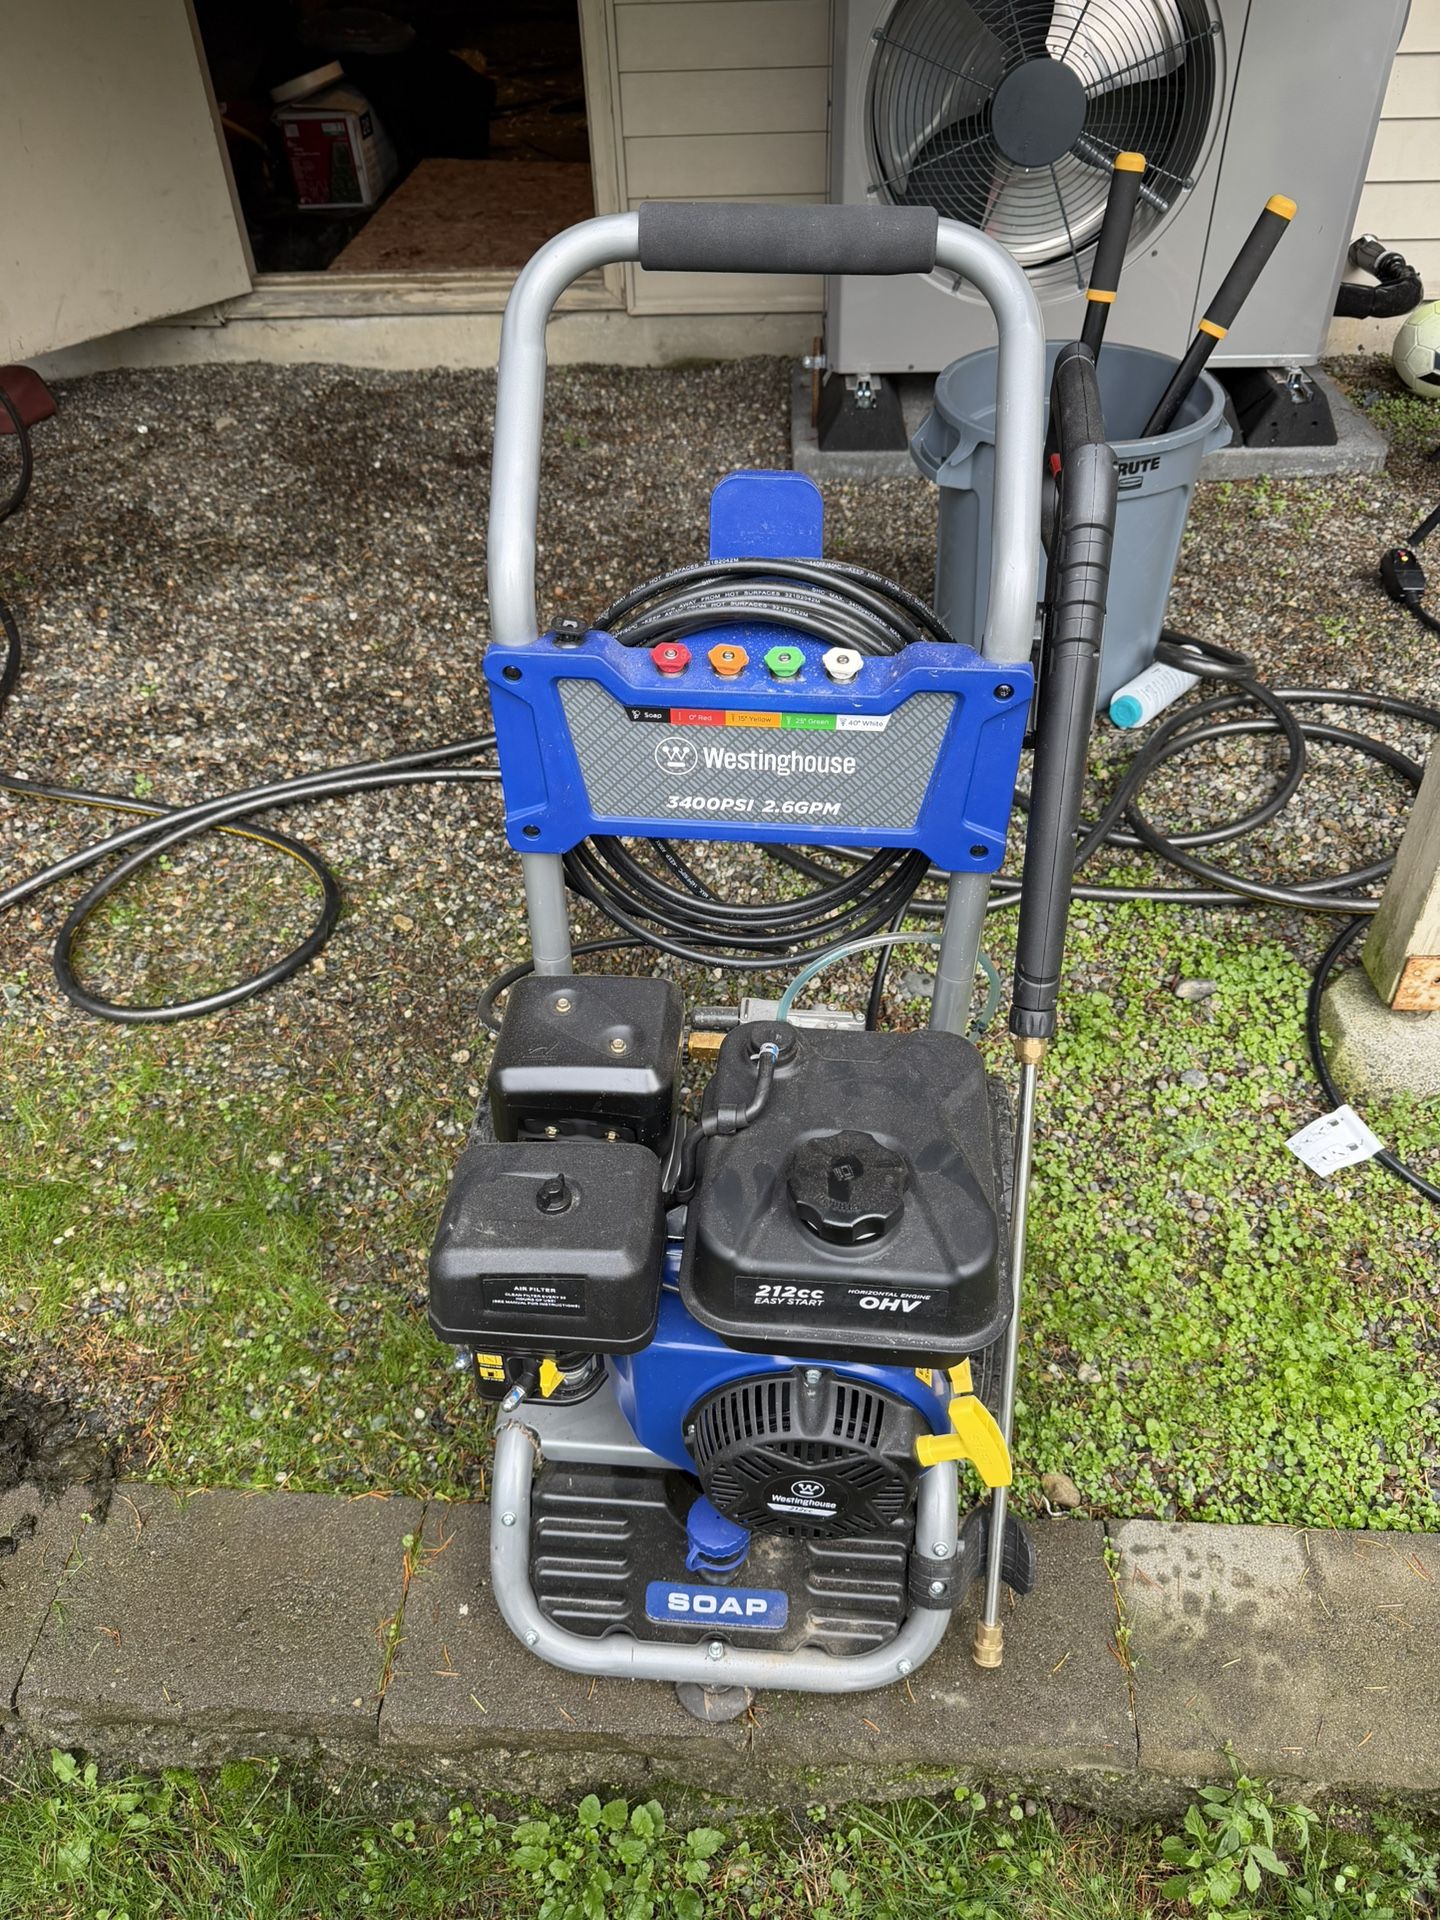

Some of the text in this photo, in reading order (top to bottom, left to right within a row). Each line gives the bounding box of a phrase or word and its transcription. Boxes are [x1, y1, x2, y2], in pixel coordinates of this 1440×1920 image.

[1119, 457, 1161, 476] RUTE
[630, 583, 646, 595] FROM
[649, 576, 661, 585] HOT
[665, 564, 699, 578] SURFACES
[679, 599, 698, 610] AWAY
[701, 594, 720, 602] FROM
[730, 601, 768, 609] SURFACES
[643, 711, 662, 720] Soap
[748, 715, 772, 723] Yellow
[703, 747, 856, 775] Westinghouse
[665, 795, 841, 816] 3400PSI 2.6GPM
[755, 1285, 824, 1299] 212cc
[848, 1289, 899, 1298] HORIZONTAL
[754, 1297, 824, 1306] EASY START
[859, 1296, 921, 1313] OHV
[772, 1494, 836, 1509] Westinghouse
[667, 1592, 767, 1616] SOAP
